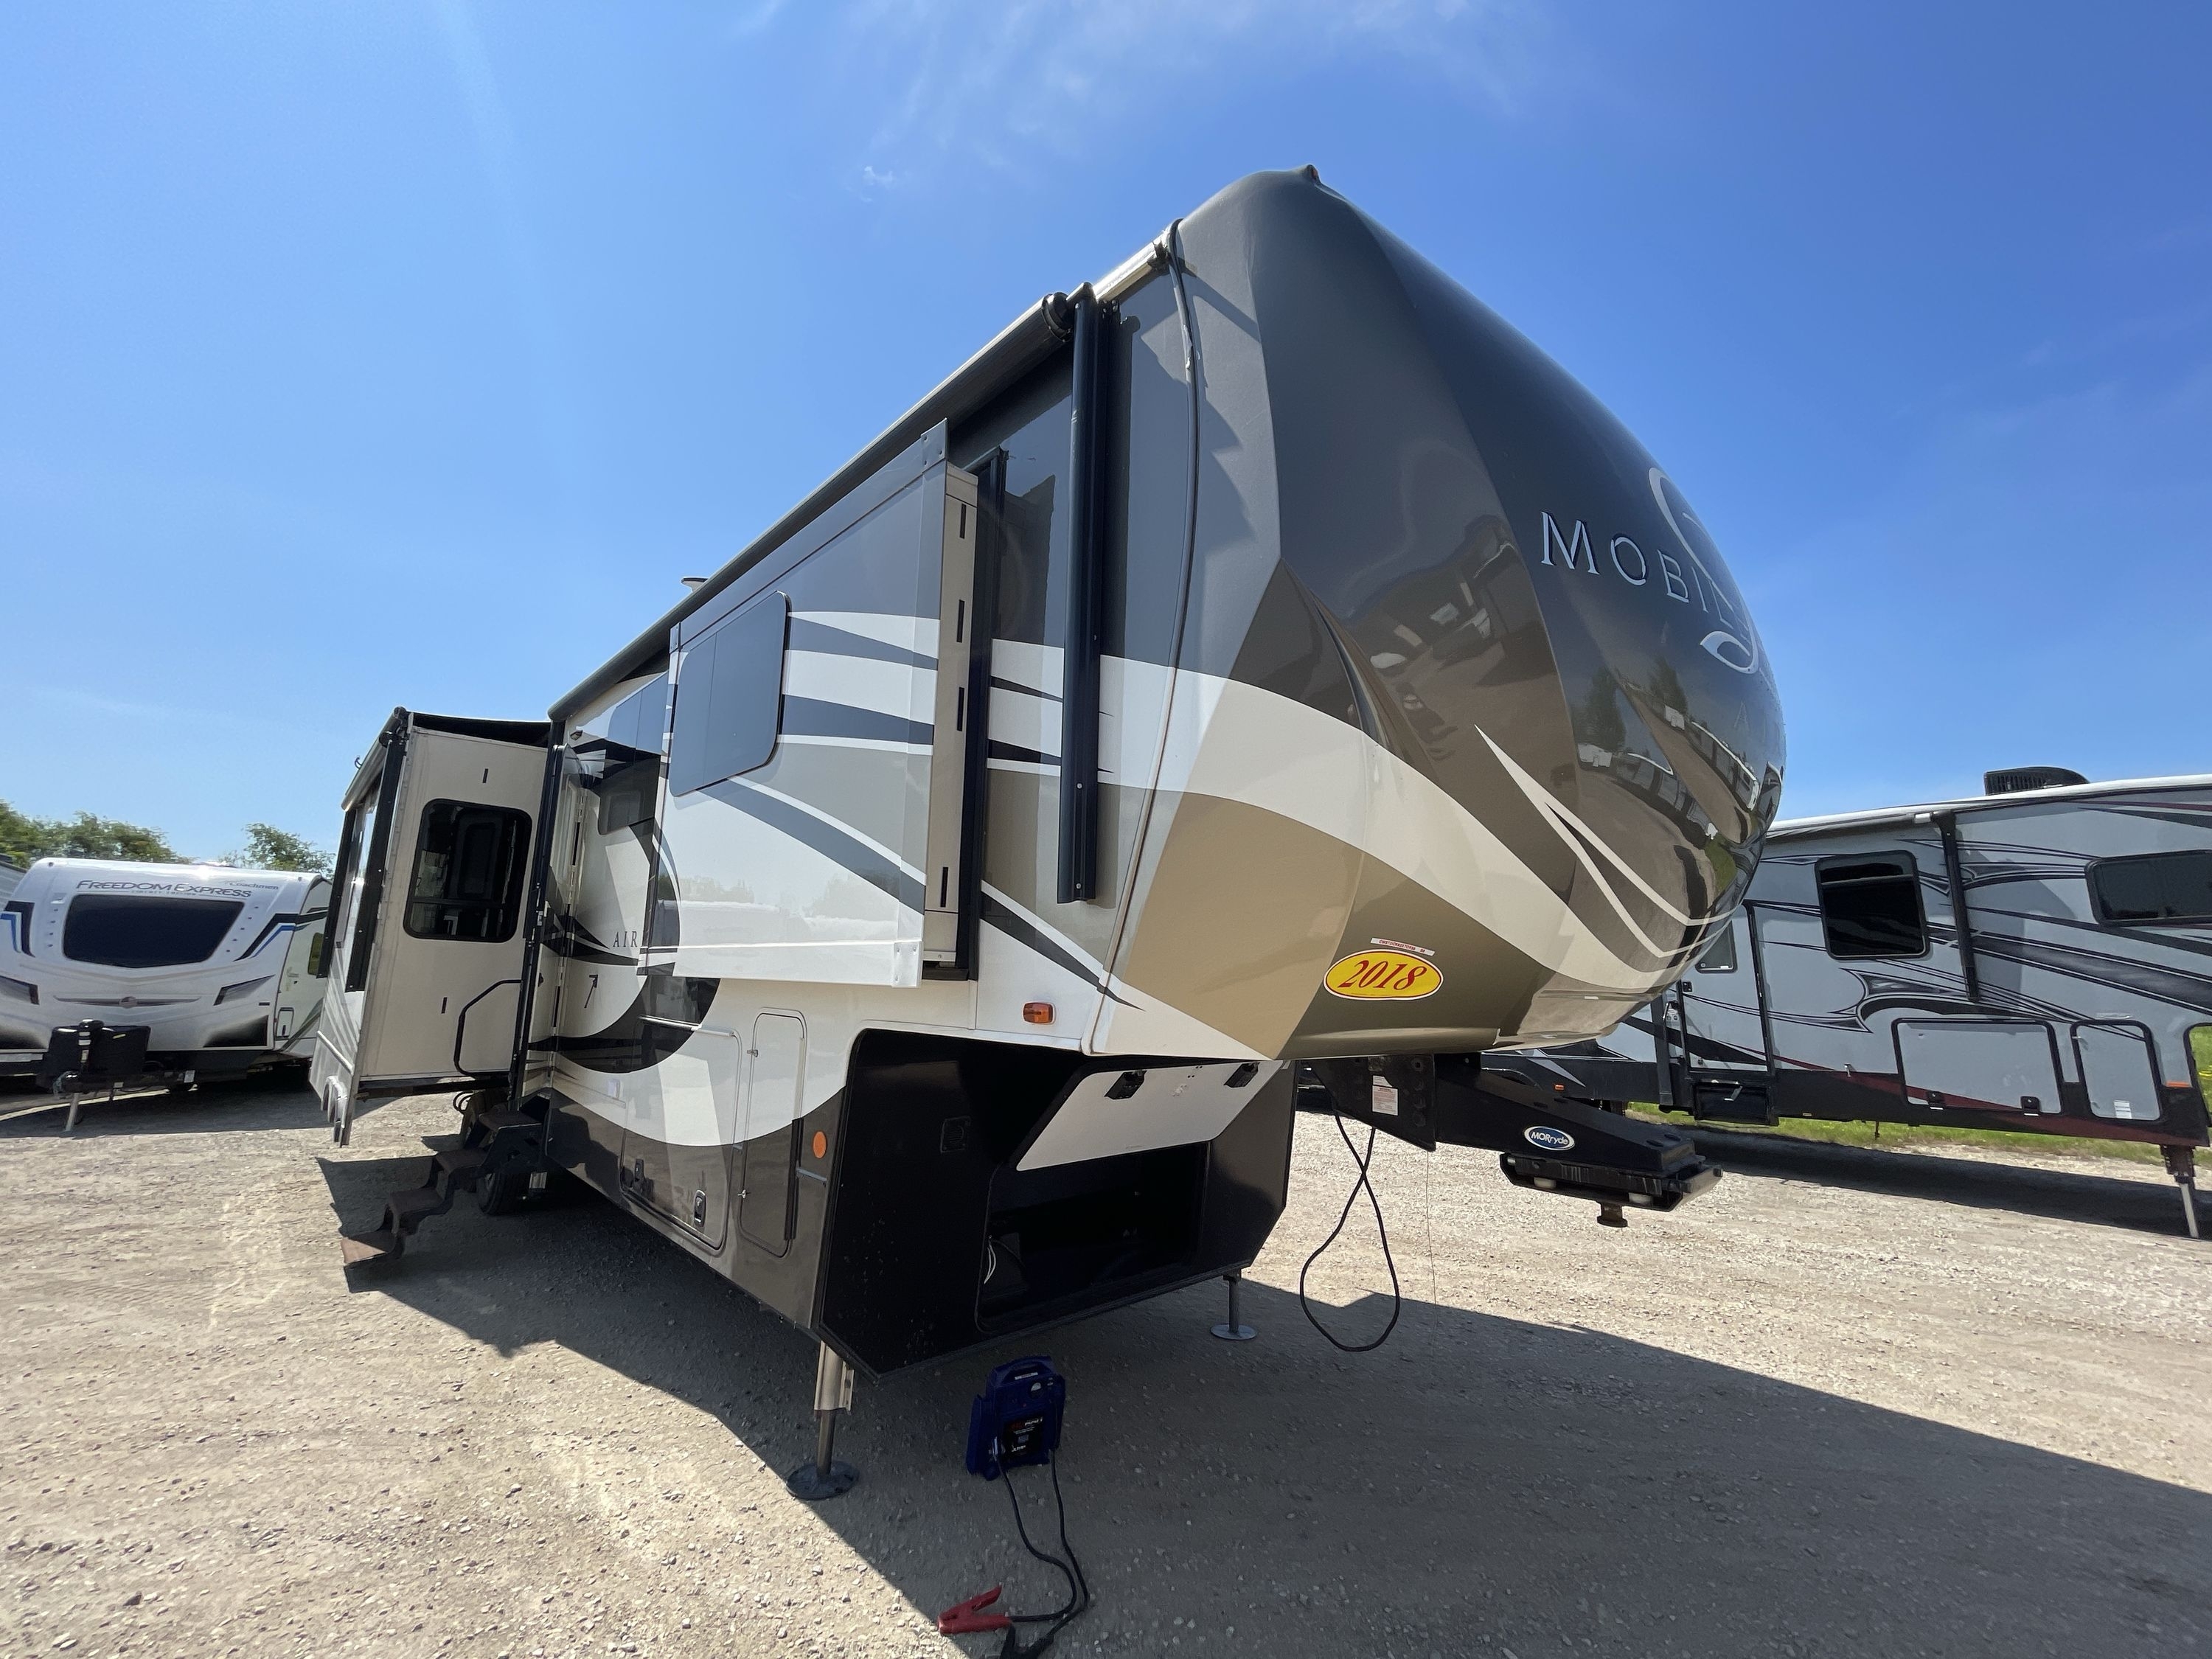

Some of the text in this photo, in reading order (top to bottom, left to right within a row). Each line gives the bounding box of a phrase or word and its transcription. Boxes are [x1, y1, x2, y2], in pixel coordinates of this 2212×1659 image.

[76, 880, 173, 891] FREEDOM
[173, 883, 251, 897] EXPRESS
[612, 931, 642, 947] AIR
[1337, 959, 1427, 991] 2018
[1530, 1131, 1568, 1145] MORryde
